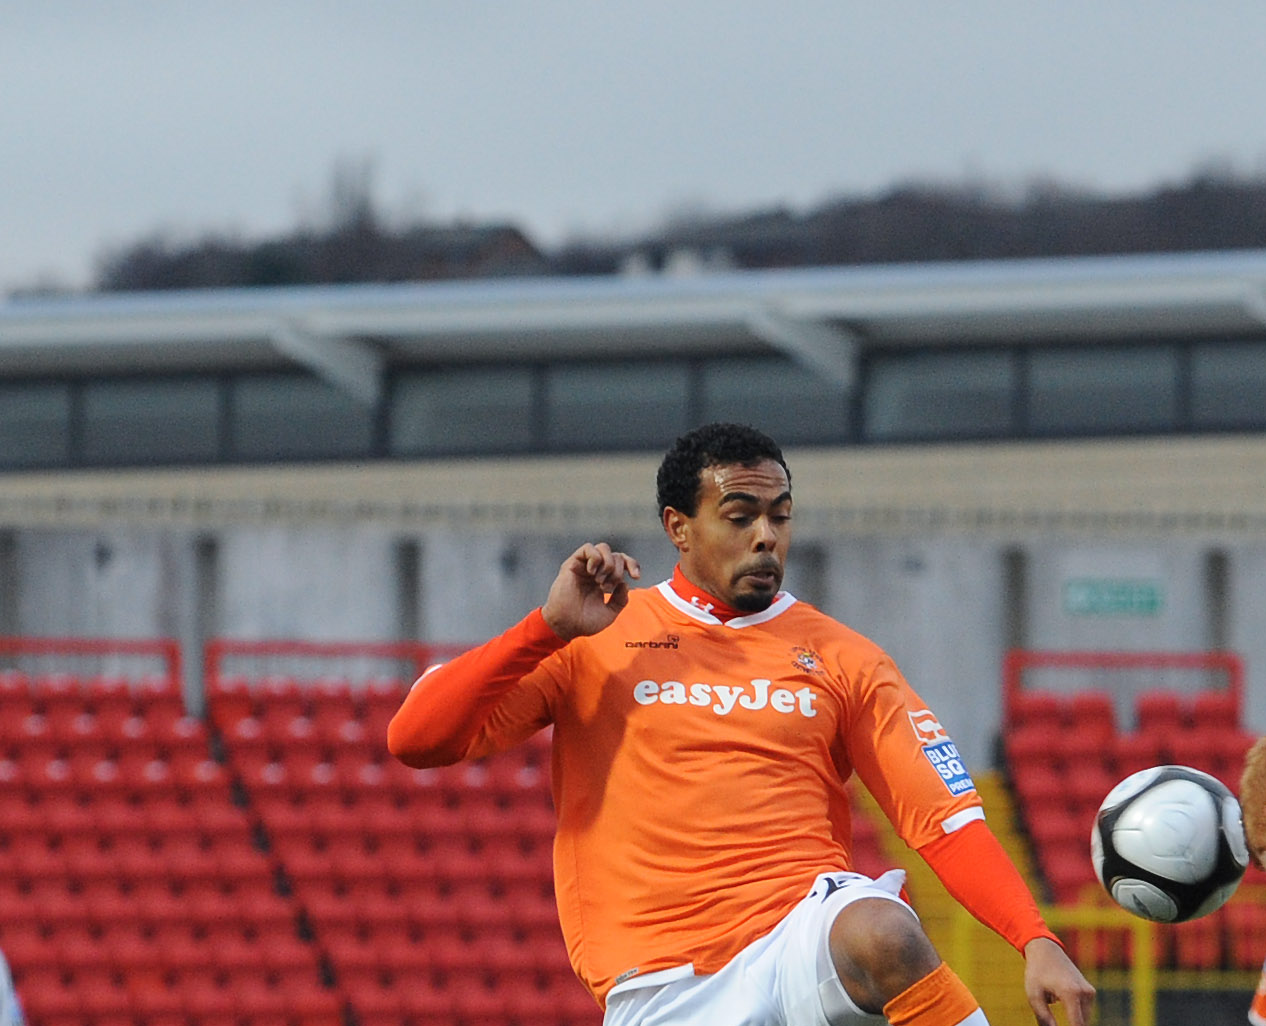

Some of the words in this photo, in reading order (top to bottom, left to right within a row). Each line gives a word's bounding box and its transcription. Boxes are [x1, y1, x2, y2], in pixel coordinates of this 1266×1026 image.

[633, 679, 817, 717] easyJet
[926, 743, 960, 764] BLU
[936, 759, 966, 780] SQ
